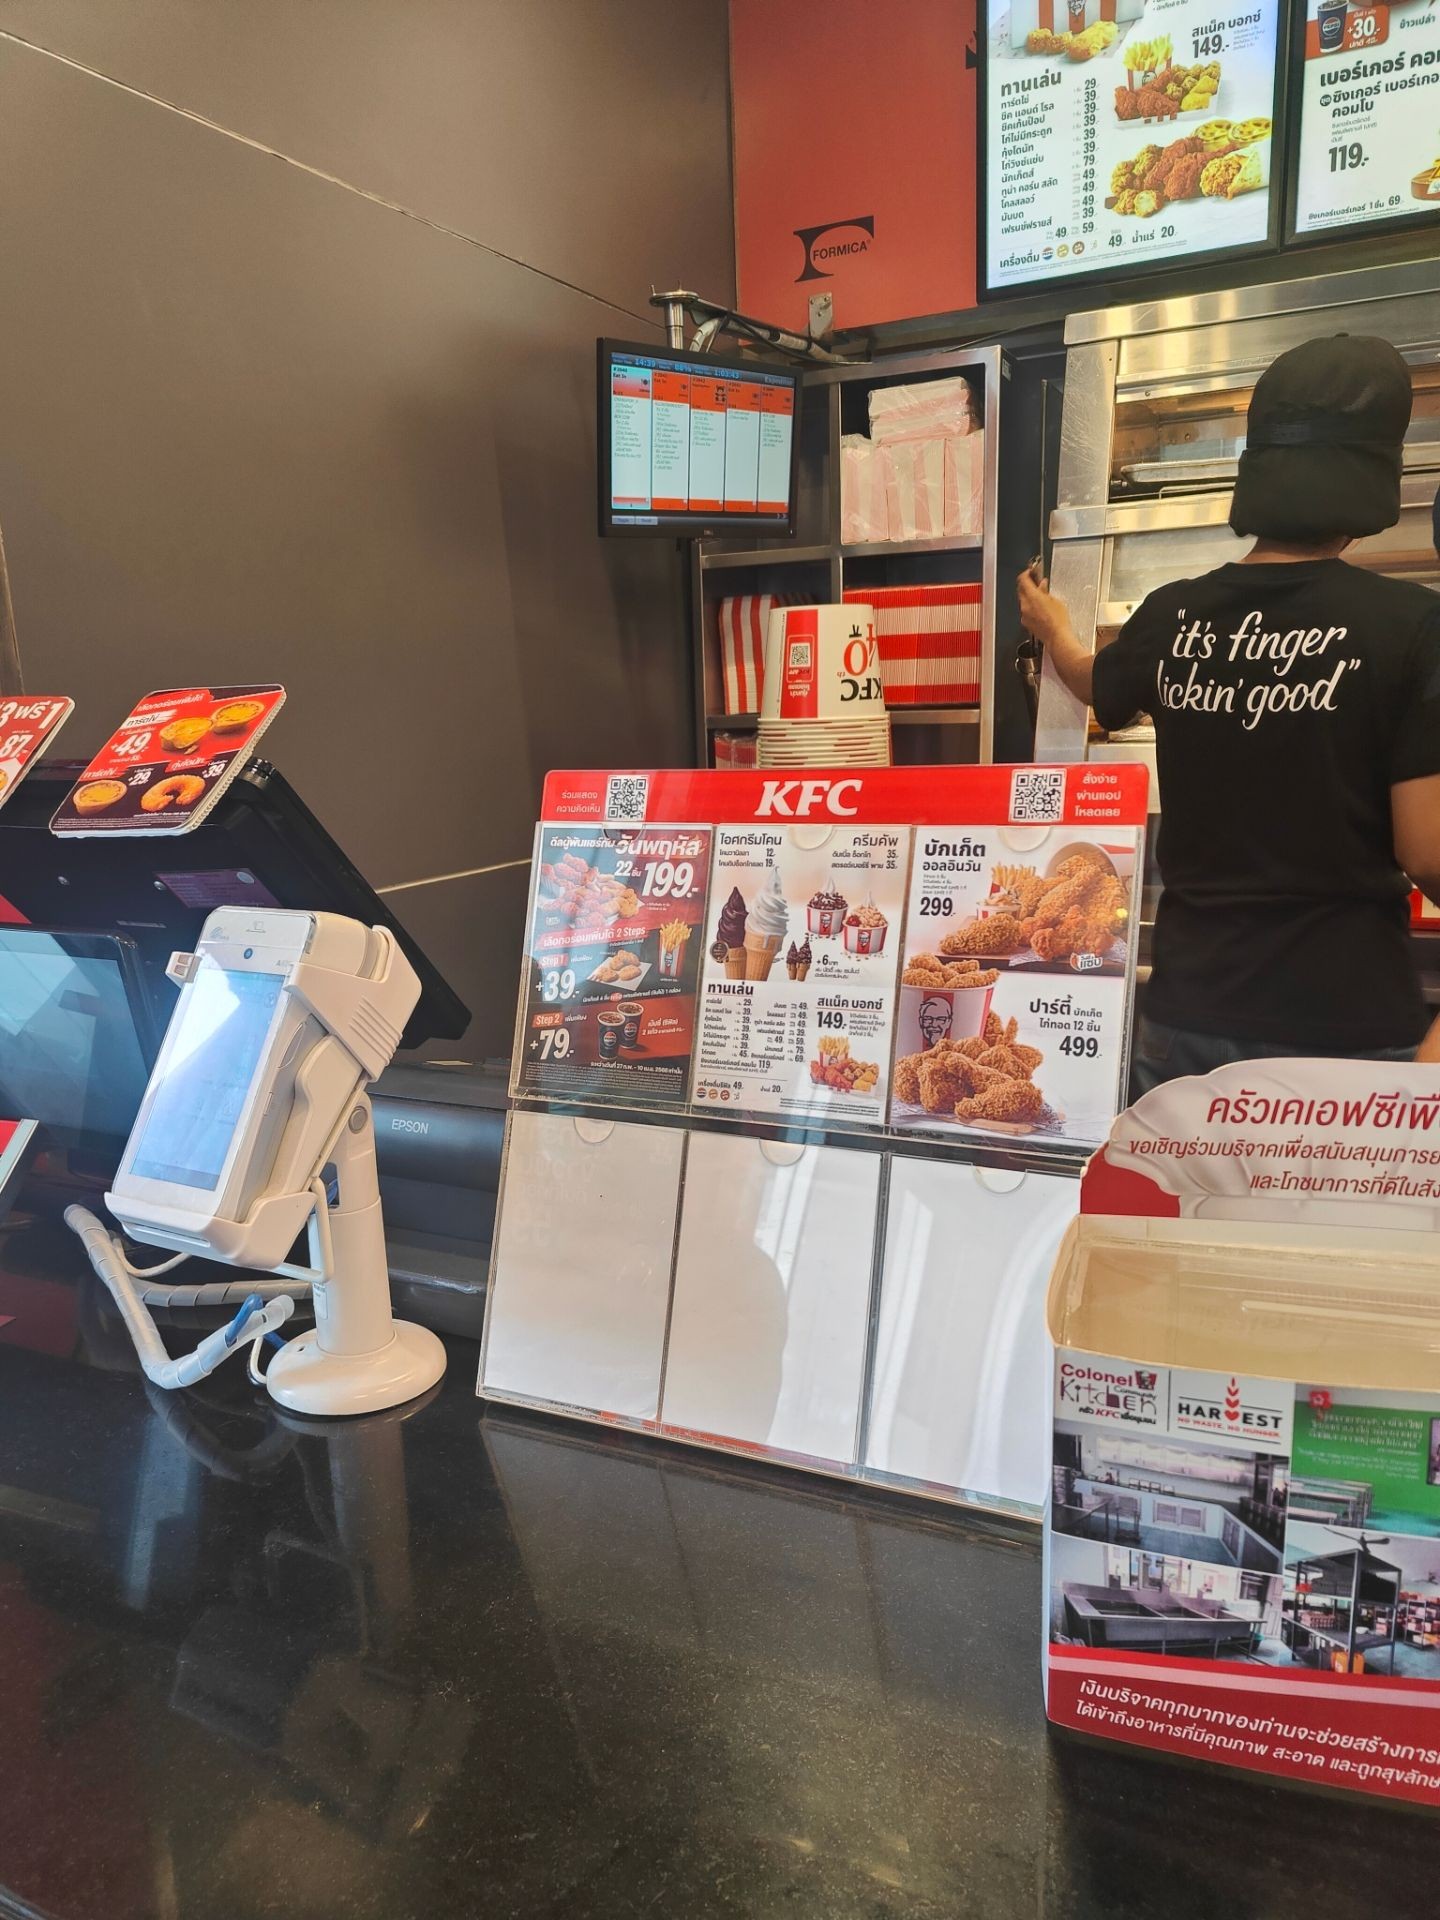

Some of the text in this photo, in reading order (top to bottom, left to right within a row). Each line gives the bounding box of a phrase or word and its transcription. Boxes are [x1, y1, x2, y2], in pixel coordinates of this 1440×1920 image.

[1192, 9, 1262, 37] สแน็ค บอกซ์
[1320, 51, 1405, 87] เบอร์เกอร์
[1001, 69, 1062, 97] ทานเล่น
[1333, 72, 1440, 104] ซิงเกอร์ เบอร์เกอ
[1332, 99, 1374, 119] คอมโบ
[813, 241, 867, 261] FORMICA
[1228, 610, 1347, 677] finger
[1157, 659, 1244, 713] lickin'
[1083, 771, 1117, 785] สั่งง่าย
[754, 779, 863, 817] KFC
[1077, 789, 1121, 801] ผ่านแอป
[1075, 806, 1120, 817] โหลดเลย
[720, 833, 782, 846] ไอศกรีมโคน
[852, 834, 898, 847] ครีมคัพ
[925, 837, 986, 857] บักเก็ต
[614, 861, 633, 877] 22
[923, 860, 981, 872] ออลอินวัน
[623, 926, 646, 938] Steps
[708, 981, 754, 995] ทานเล่น
[817, 995, 884, 1010] สแน็ค บอกซ์
[1029, 995, 1102, 1018] ปาร์ตี้ บักเก็ต
[1039, 1017, 1101, 1032] ไก่ทอด 12 ชิ้น
[1206, 1089, 1440, 1132] ครัวเคเอฟซีเพื
[392, 1118, 428, 1133] EPSON
[1061, 1363, 1132, 1386] Colonel
[1095, 1409, 1120, 1419] KFC
[1080, 1679, 1440, 1765] เงินบริจาคทุกบาทของท่านจะช่วยสร้างการ
[1076, 1699, 1268, 1757] ได้เข้าถึงอาหารที่มีคุณภาพ
[1273, 1745, 1325, 1769] สะอาด
